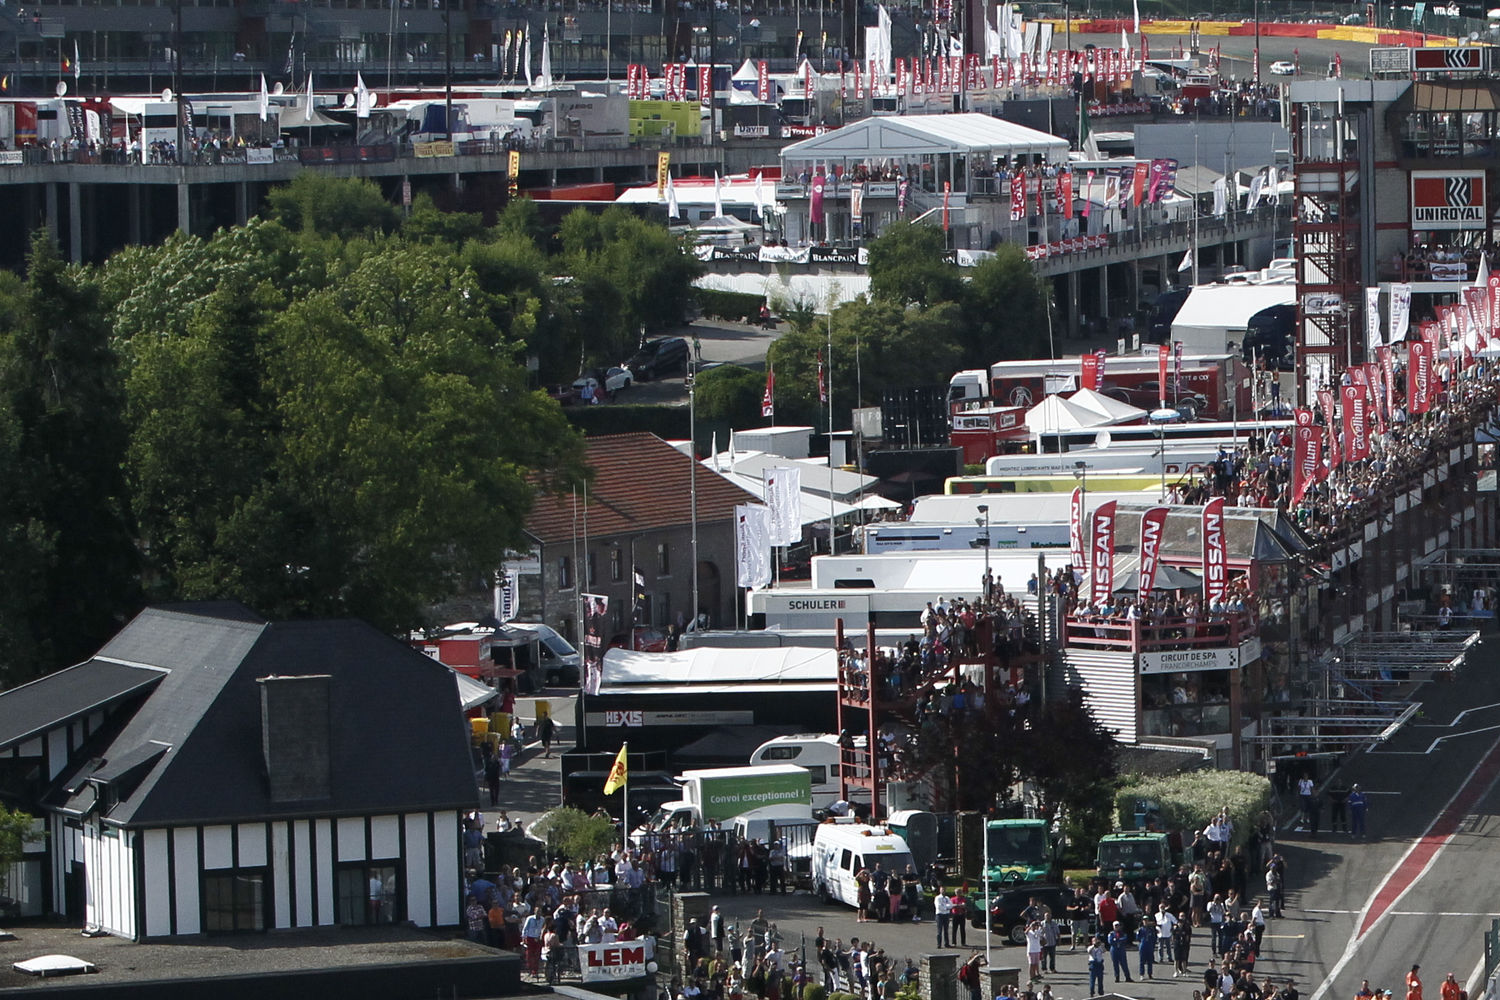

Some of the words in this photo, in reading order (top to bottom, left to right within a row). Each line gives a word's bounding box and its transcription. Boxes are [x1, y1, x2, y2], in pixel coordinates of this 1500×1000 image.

[791, 127, 815, 135] TOTAL
[1416, 207, 1482, 220] UNIROYAL
[715, 251, 757, 260] BLANCPAIN
[812, 253, 857, 262] BLANCPAIN
[1415, 354, 1428, 404] excellium
[1351, 399, 1363, 450] excellium
[1095, 516, 1111, 607] NISSAN
[1207, 513, 1223, 605] NISSAN
[789, 600, 837, 610] SCHULER
[1161, 654, 1189, 662] CIRCUIT
[1191, 653, 1201, 661] DE
[1203, 652, 1217, 660] SPA
[1161, 661, 1217, 669] FRANCORCHAMPS
[606, 711, 643, 727] HEXIS
[710, 794, 740, 803] Convoi
[742, 790, 799, 803] exceptionnel
[588, 946, 644, 967] LEM
